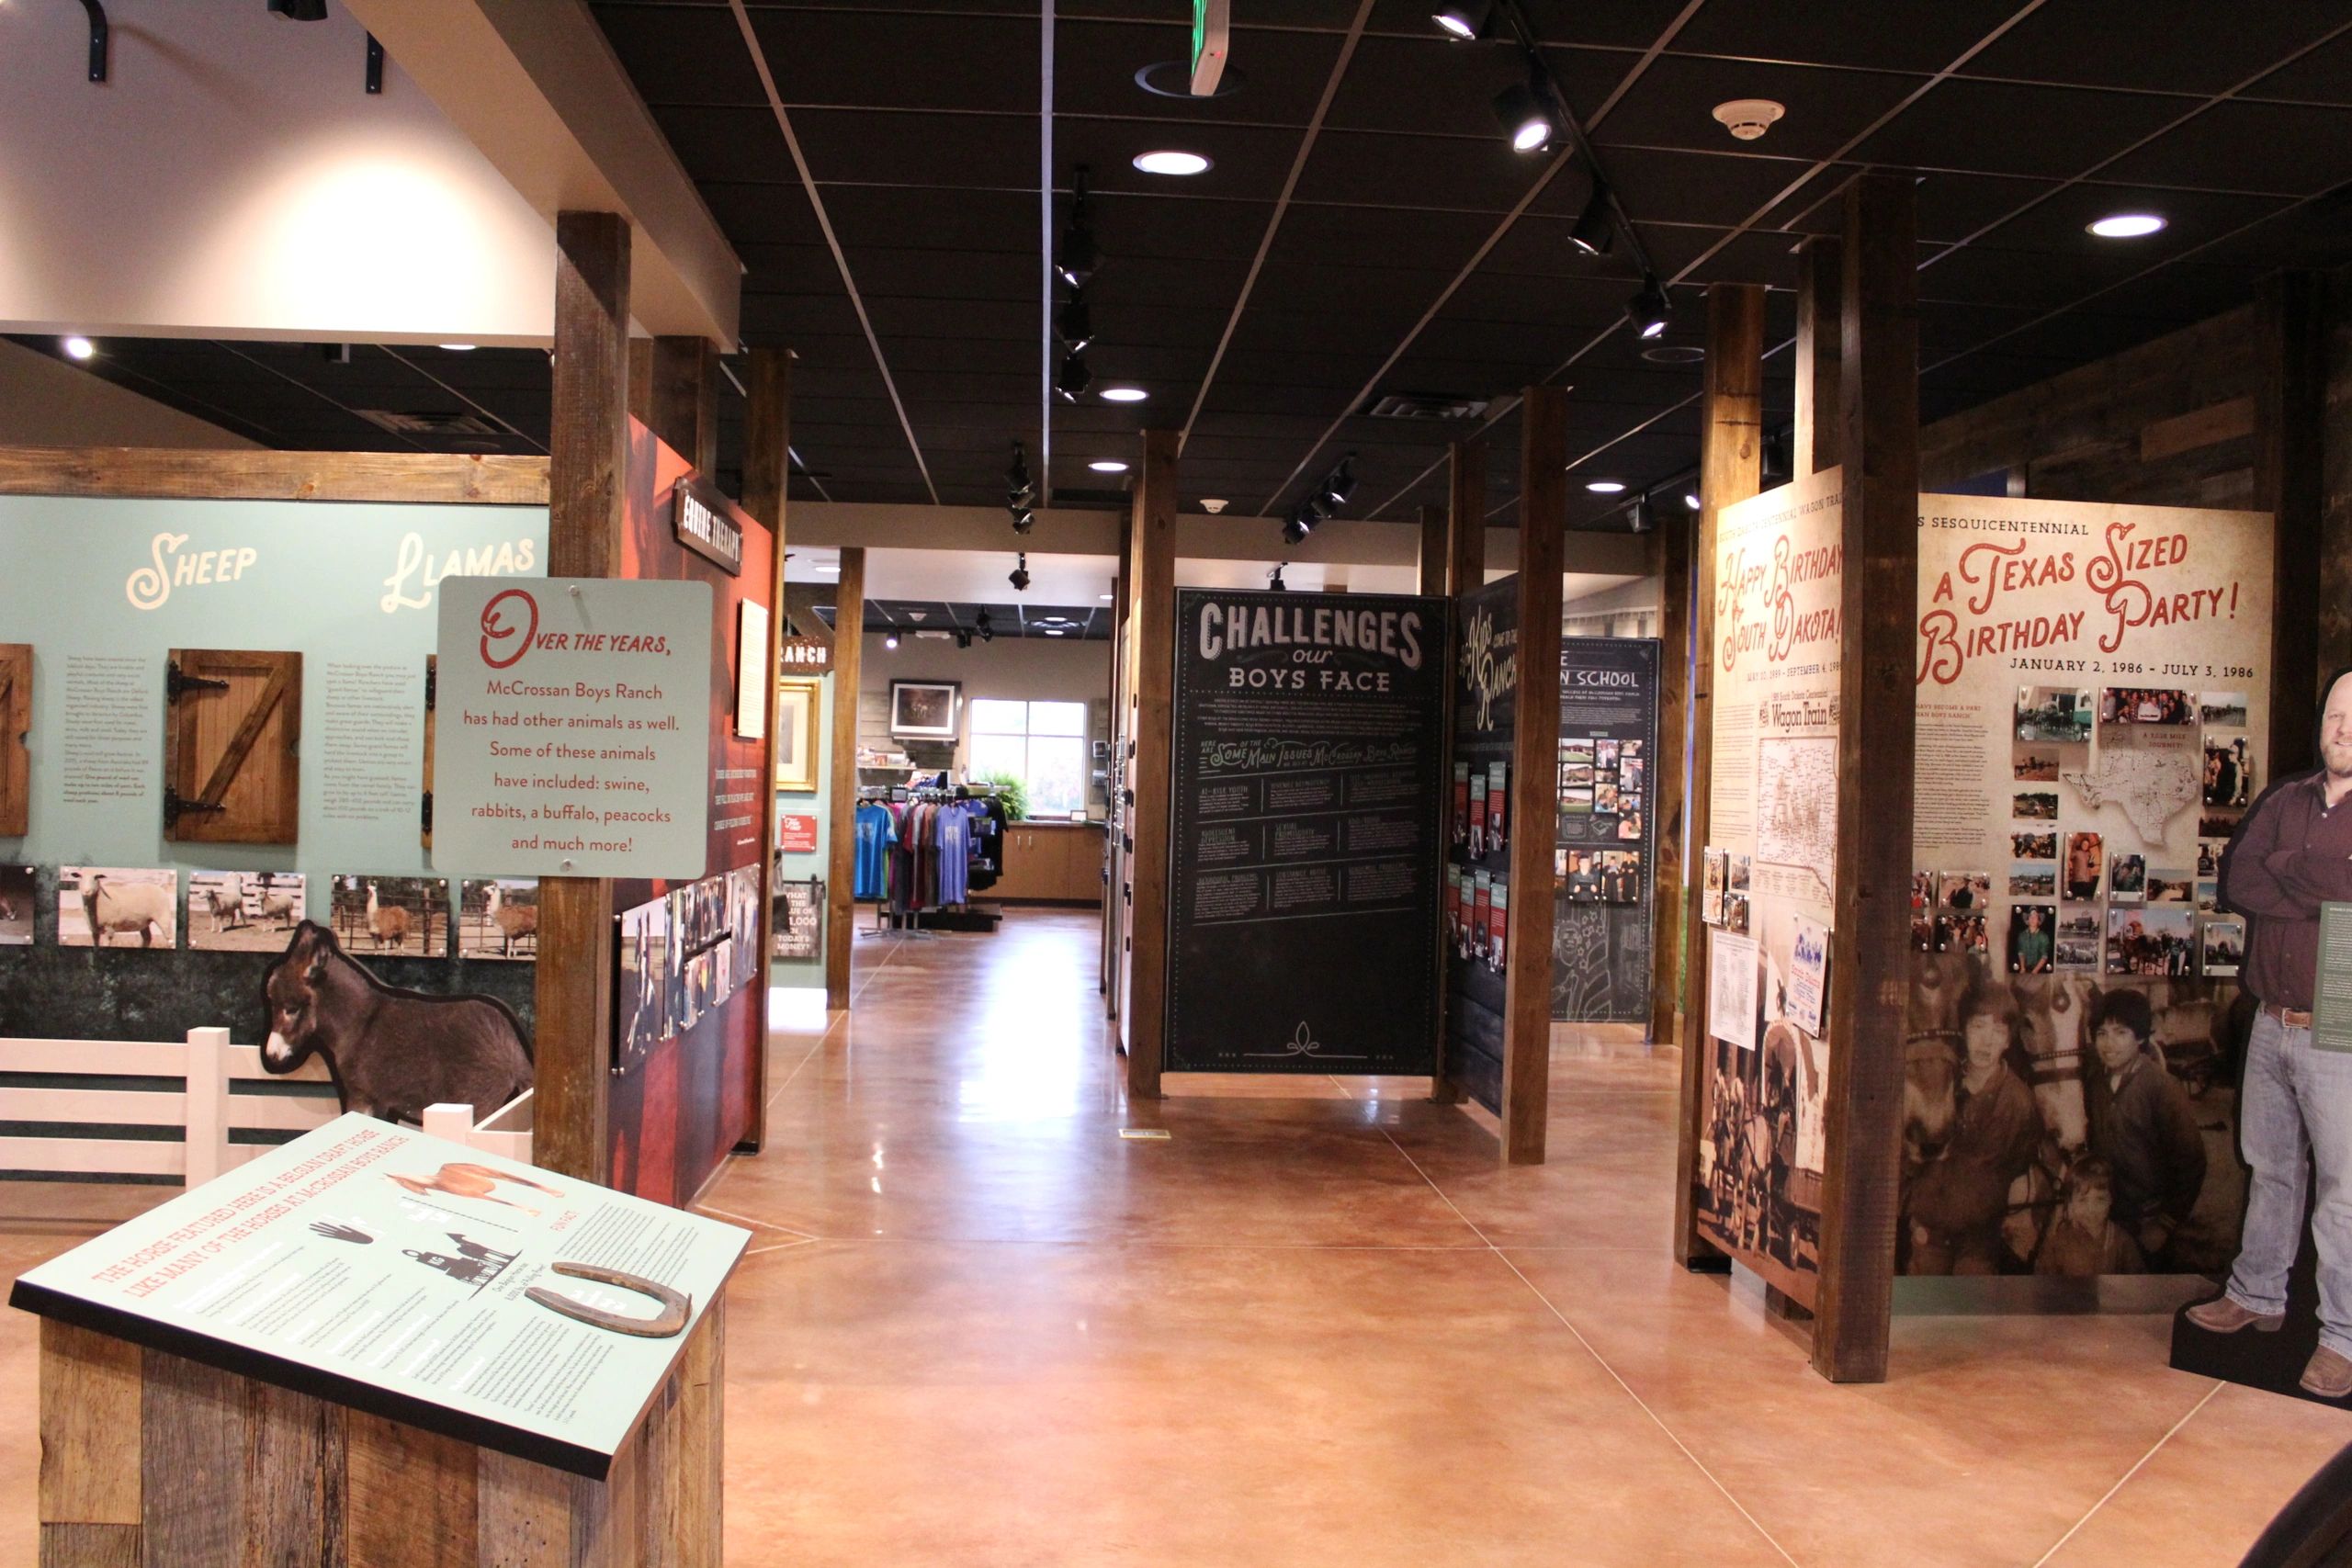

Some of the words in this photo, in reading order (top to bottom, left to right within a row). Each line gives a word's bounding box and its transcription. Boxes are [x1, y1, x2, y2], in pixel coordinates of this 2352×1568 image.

[1799, 498, 1824, 514] WAGON
[1826, 492, 1842, 508] TRAI
[1931, 517, 2089, 536] SESQUICENTENNIAL
[126, 532, 257, 611] SHEEP
[379, 531, 535, 615] LLAMAS
[1718, 547, 1767, 616] HAPPY
[1764, 535, 1842, 608] BIRTHDAY
[1933, 571, 1953, 604] A
[1959, 537, 2075, 615] TEXAS
[2086, 522, 2188, 594] SIZED
[480, 589, 569, 670] OVER
[573, 634, 606, 651] THE
[610, 636, 672, 656] YEARS,
[1200, 603, 1422, 671] CHALLENGES
[1723, 592, 1766, 672] SOUTH
[1293, 649, 1333, 663] our
[1916, 609, 2086, 685] BIRTHDAY
[1230, 668, 1305, 689] BOYS
[1320, 671, 1389, 691] FACE
[1577, 671, 1639, 687] SCHOOL
[1787, 663, 1820, 677] SEPTEMBER
[2010, 658, 2086, 672] JANUARY
[2093, 660, 2105, 673] 2,
[2113, 662, 2143, 673] 1986
[2162, 664, 2199, 676] JULY
[2205, 666, 2217, 678] 3,
[2223, 666, 2253, 678] 1986
[487, 681, 569, 697] McCrossan
[575, 682, 610, 703] Boys
[616, 683, 662, 699] Ranch
[1477, 651, 1518, 731] RANCH
[464, 710, 487, 726] has
[492, 711, 518, 727] had
[523, 712, 563, 728] other
[568, 714, 623, 729] animals
[628, 720, 642, 729] as
[646, 716, 680, 731] well.
[1771, 703, 1802, 733] Wagon
[1803, 701, 1826, 726] Train
[490, 741, 531, 757] Some
[537, 743, 553, 758] of
[556, 744, 595, 759] these
[600, 745, 655, 761] animals
[494, 773, 527, 787] have
[532, 774, 599, 790] included:
[605, 777, 650, 793] swine,
[471, 803, 526, 820] rabbits,
[531, 809, 538, 819] a
[544, 805, 599, 823] buffalo,
[604, 807, 671, 826] peacocks
[512, 835, 538, 850] and
[544, 836, 584, 851] much
[590, 838, 632, 852] more!
[92, 1265, 133, 1283] THE
[121, 1241, 177, 1267] HORSE
[166, 1208, 237, 1242] FEATURED
[226, 1192, 265, 1210] HERE
[254, 1186, 277, 1194] IS
[276, 1159, 324, 1182] BELGIAN
[315, 1144, 353, 1161] DRAFT
[344, 1130, 379, 1145] HORSE
[122, 1277, 167, 1297] LIKE
[154, 1251, 210, 1279] MANY
[199, 1241, 228, 1253] OF
[216, 1227, 251, 1243] THE
[240, 1203, 290, 1229] HORSES
[283, 1195, 306, 1206] AT
[295, 1164, 358, 1197] McCROSSAN
[349, 1152, 379, 1166] BOYS
